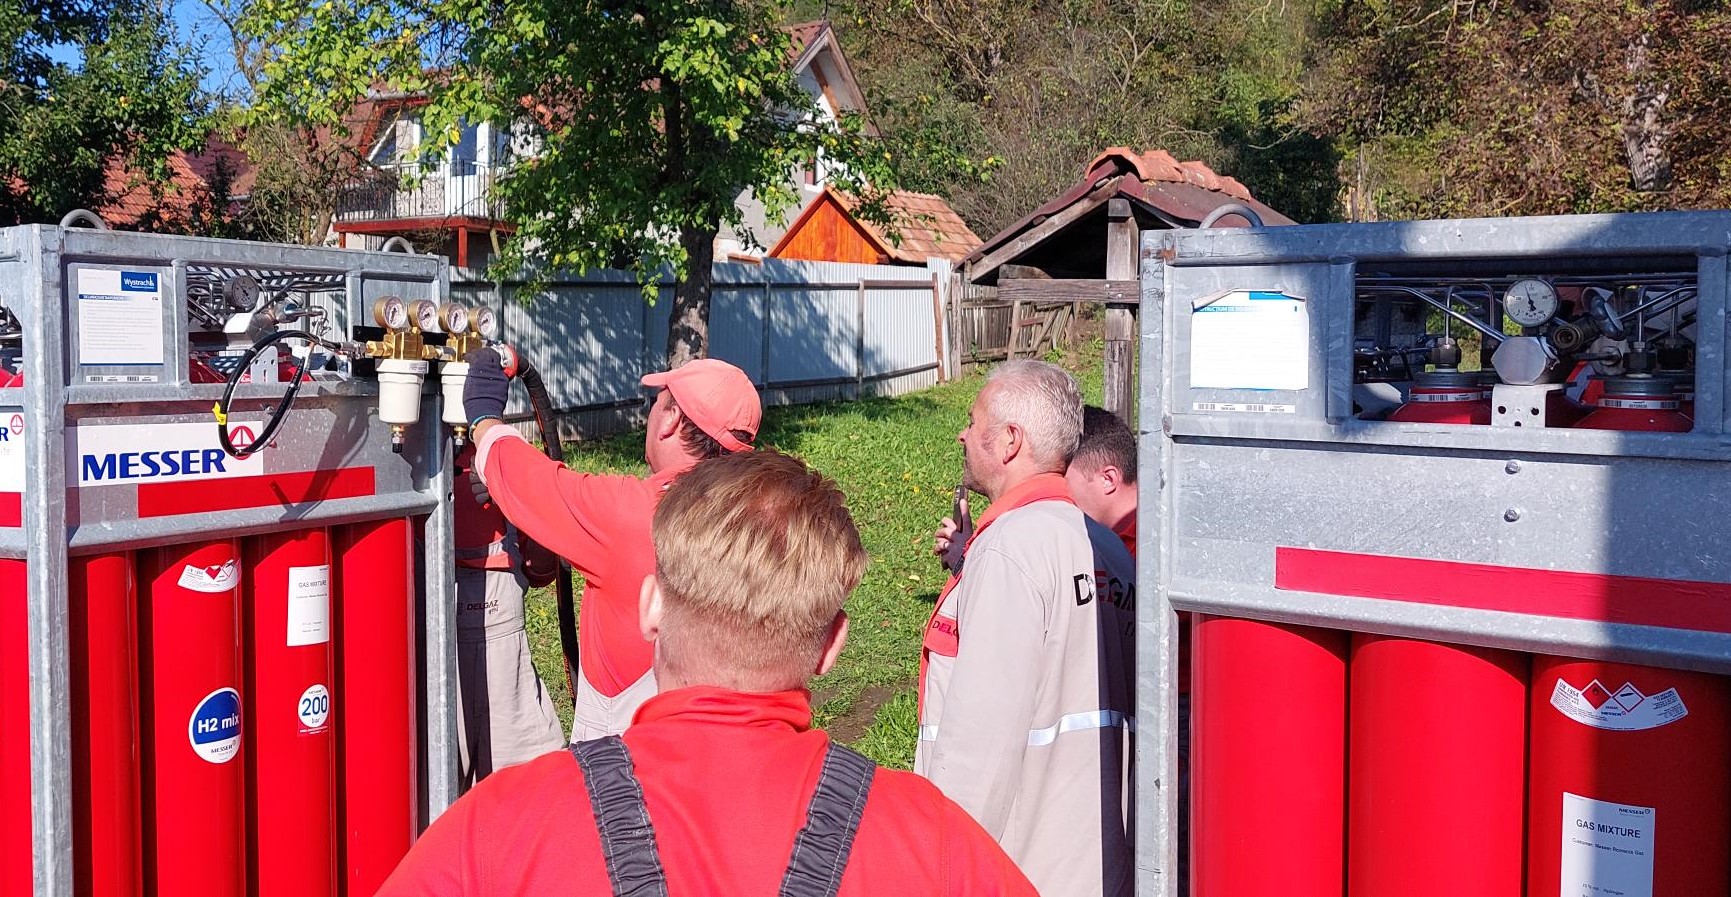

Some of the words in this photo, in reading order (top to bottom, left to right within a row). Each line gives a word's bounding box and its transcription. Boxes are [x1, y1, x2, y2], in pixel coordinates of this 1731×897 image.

[123, 277, 150, 287] Wystrach
[82, 449, 227, 481] MESSER
[301, 694, 328, 717] 200
[197, 717, 219, 734] H2
[221, 712, 240, 730] mix
[210, 743, 233, 754] MESSER
[1576, 819, 1595, 831] GAS
[1597, 823, 1642, 839] MIXTURE
